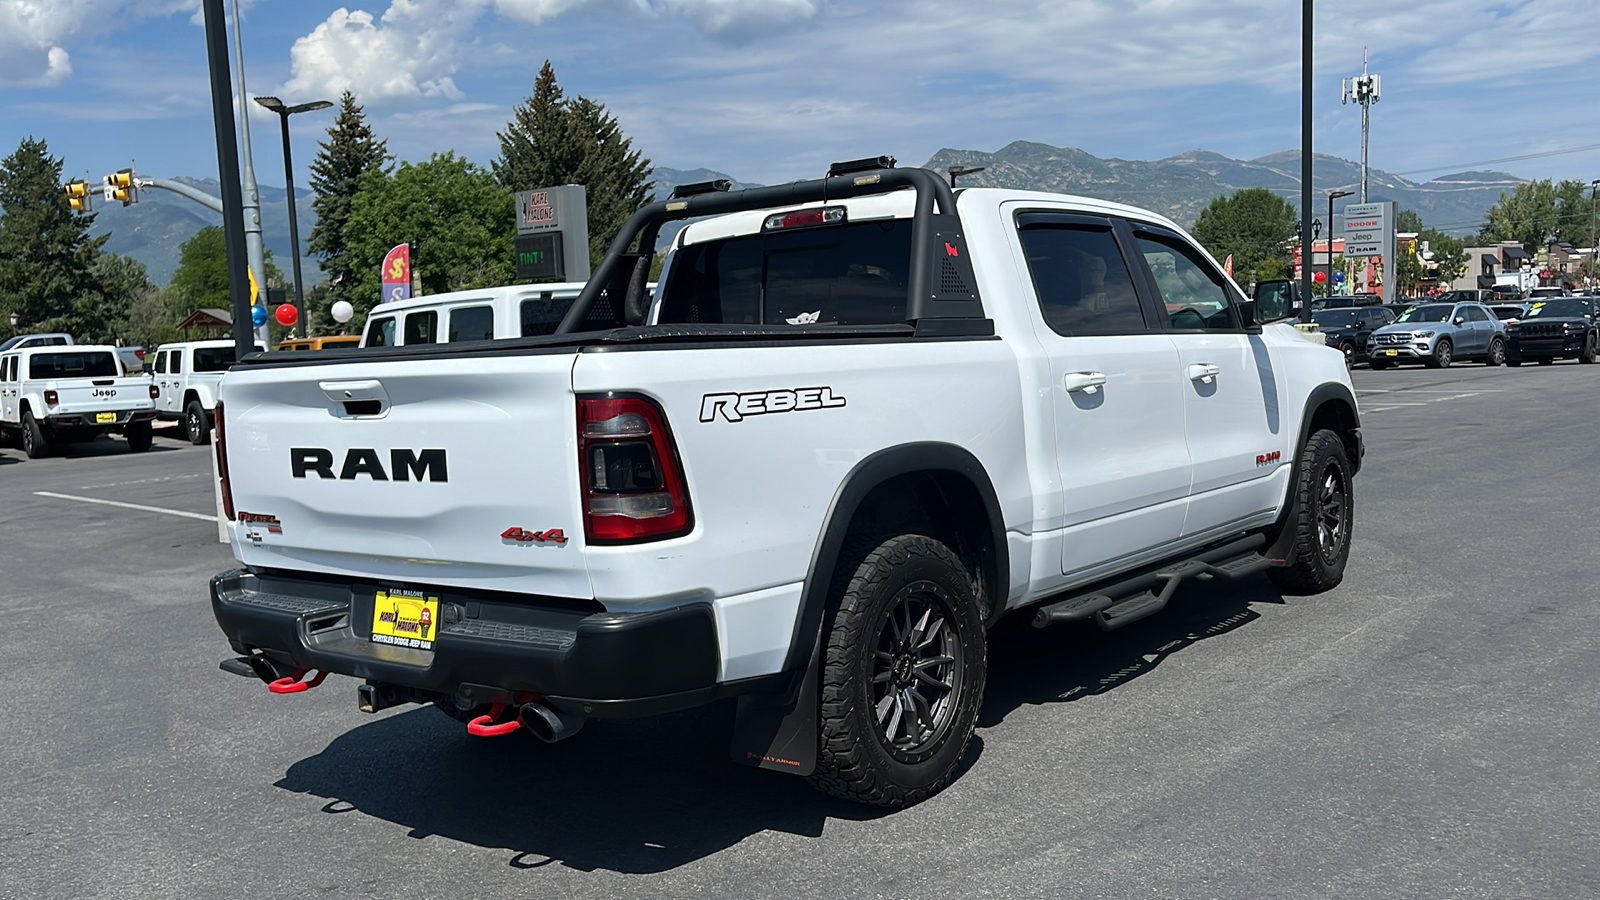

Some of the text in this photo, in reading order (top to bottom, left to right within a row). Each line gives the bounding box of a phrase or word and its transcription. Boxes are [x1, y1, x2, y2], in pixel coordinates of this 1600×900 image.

[531, 192, 549, 206] KARL
[527, 207, 554, 222] MALONE
[1353, 233, 1372, 241] Jeep
[92, 389, 116, 397] Jeep
[699, 386, 847, 423] REBEL
[1256, 451, 1280, 464] RAM
[290, 448, 448, 482] RAM
[379, 611, 395, 622] KARL
[422, 611, 430, 620] 32
[396, 621, 419, 633] MALONE
[372, 634, 394, 644] CHRYSLER
[394, 637, 409, 646] DODGE
